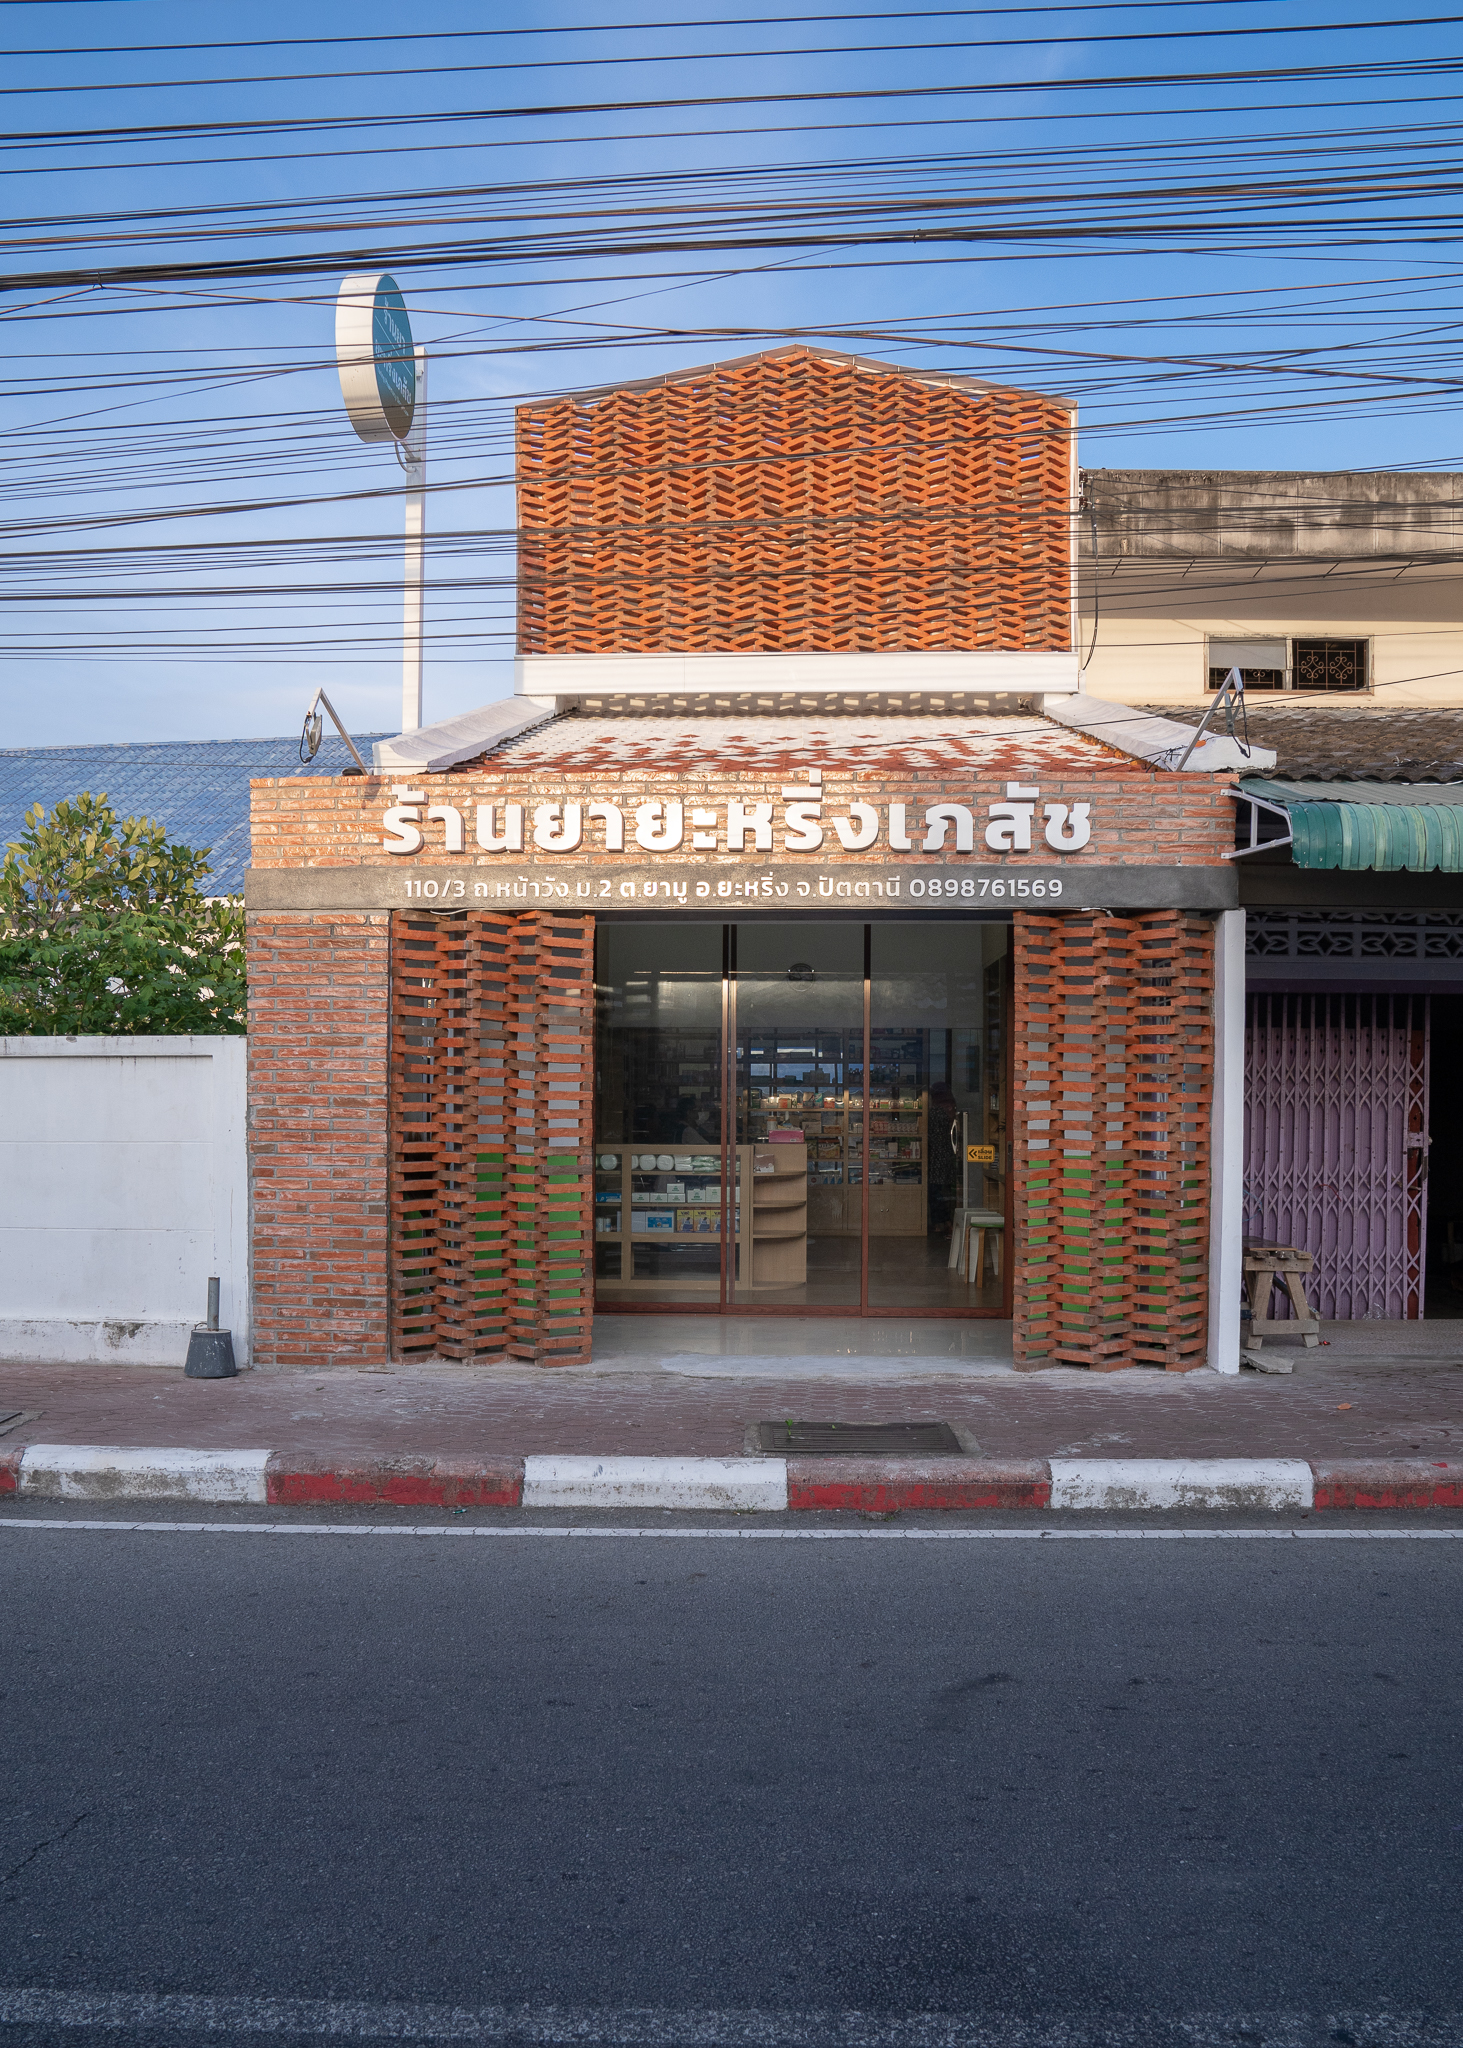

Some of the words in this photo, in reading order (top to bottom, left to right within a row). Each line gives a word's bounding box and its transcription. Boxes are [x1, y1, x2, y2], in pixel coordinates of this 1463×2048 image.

[382, 769, 1092, 855] ร้านยายะหริ่งเภสัช
[404, 879, 466, 898] 110/3
[474, 876, 569, 898] ถ.หน้าวัง
[576, 879, 612, 898] ม.2
[619, 880, 688, 905] ต.ยามู
[695, 871, 789, 898] อ.ยะหริ่ง
[796, 875, 901, 898] จ.ปัตตานี
[908, 878, 1063, 898] 0898761569
